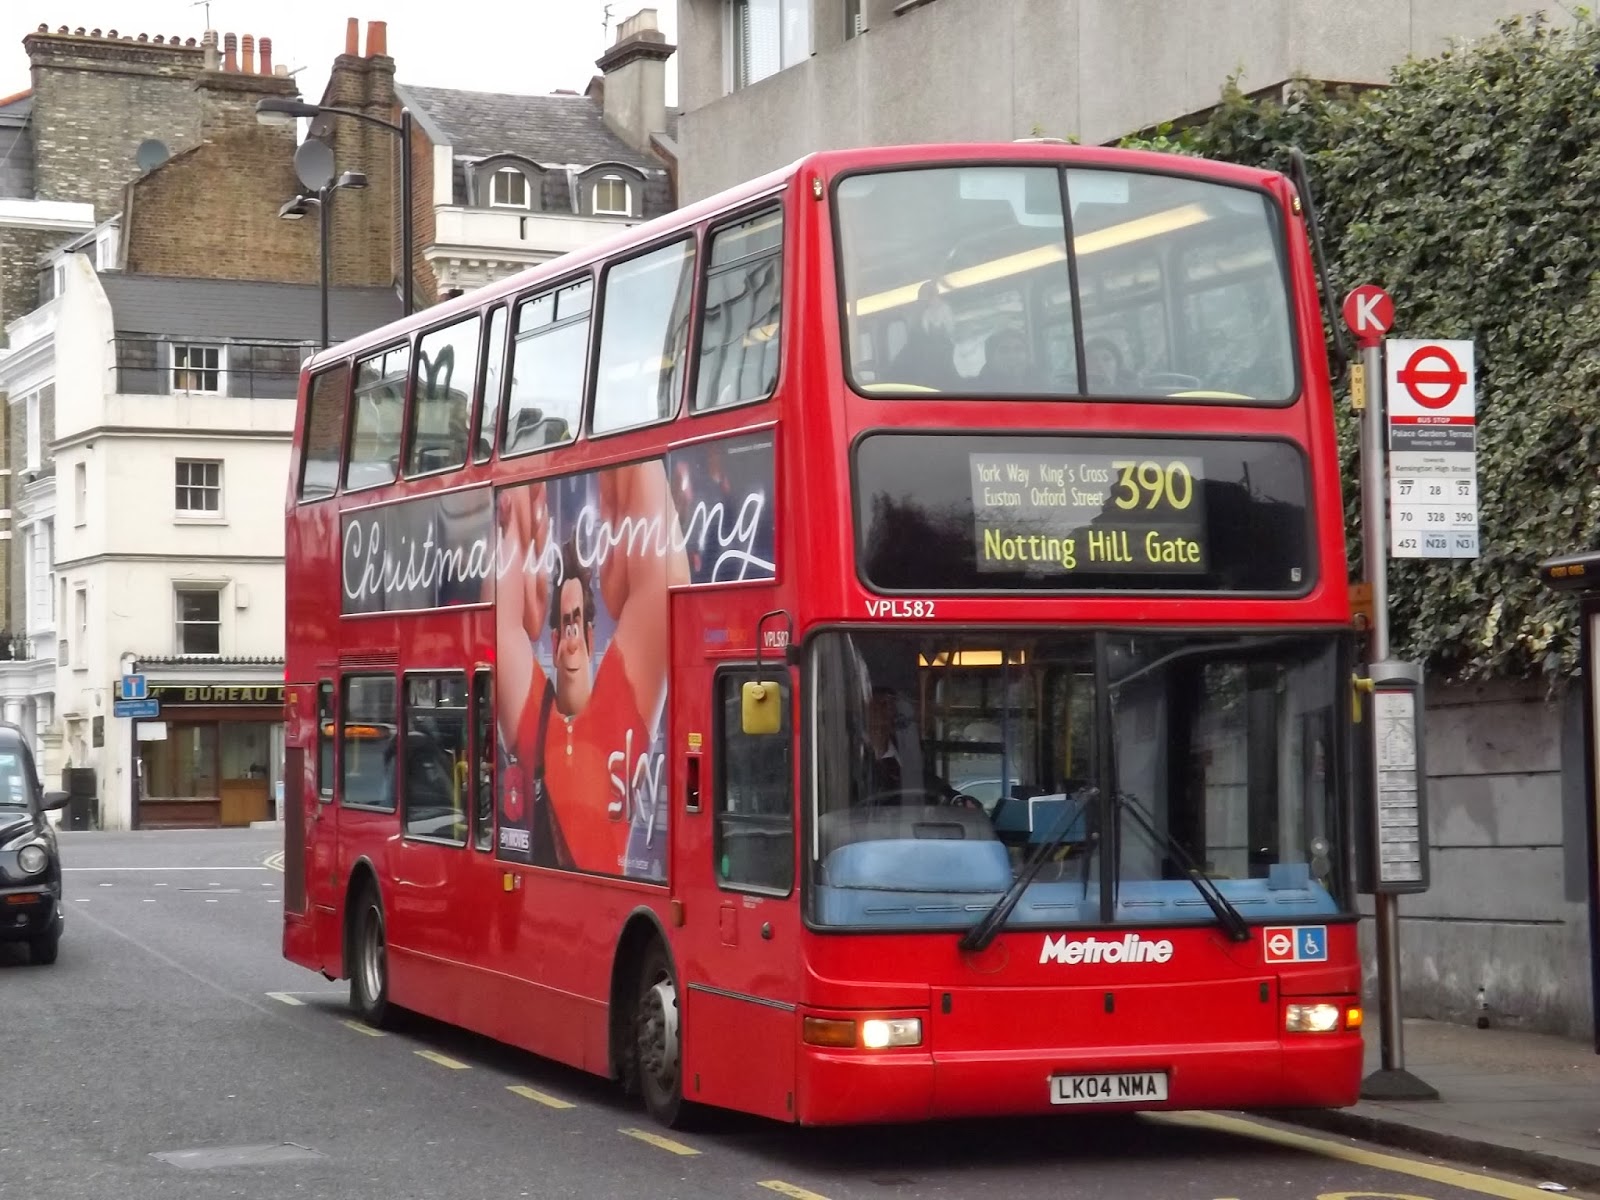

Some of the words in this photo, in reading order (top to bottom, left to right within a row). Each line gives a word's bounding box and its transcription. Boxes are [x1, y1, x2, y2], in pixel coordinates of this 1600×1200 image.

[1357, 293, 1386, 331] K
[1392, 429, 1416, 437] Palace
[1417, 429, 1447, 438] Gardens
[1448, 430, 1474, 438] Terrace
[977, 463, 1001, 482] York
[1006, 463, 1030, 488] Way
[1039, 463, 1075, 487] King's
[1079, 464, 1109, 483] Cross
[1111, 460, 1193, 510] 390
[1400, 486, 1412, 495] 27
[1429, 486, 1442, 495] 28
[1457, 486, 1469, 496] 52
[984, 487, 1022, 506] Euston
[1030, 487, 1067, 506] Oxford
[1071, 488, 1105, 506] Street
[1400, 512, 1413, 522] 70
[1427, 512, 1446, 522] 328
[1455, 512, 1473, 522] 390
[984, 528, 1077, 569] Notting
[1088, 530, 1133, 562] Hill
[1145, 530, 1201, 563] Gate
[1398, 539, 1417, 548] 452
[1426, 539, 1447, 549] N28
[1456, 539, 1474, 549] N31
[342, 518, 515, 600] Christmas
[865, 600, 935, 618] VPL582
[184, 687, 268, 701] BUREAU
[1038, 934, 1174, 965] Metroline
[1058, 1077, 1112, 1100] LK04
[1118, 1074, 1157, 1097] NMA
